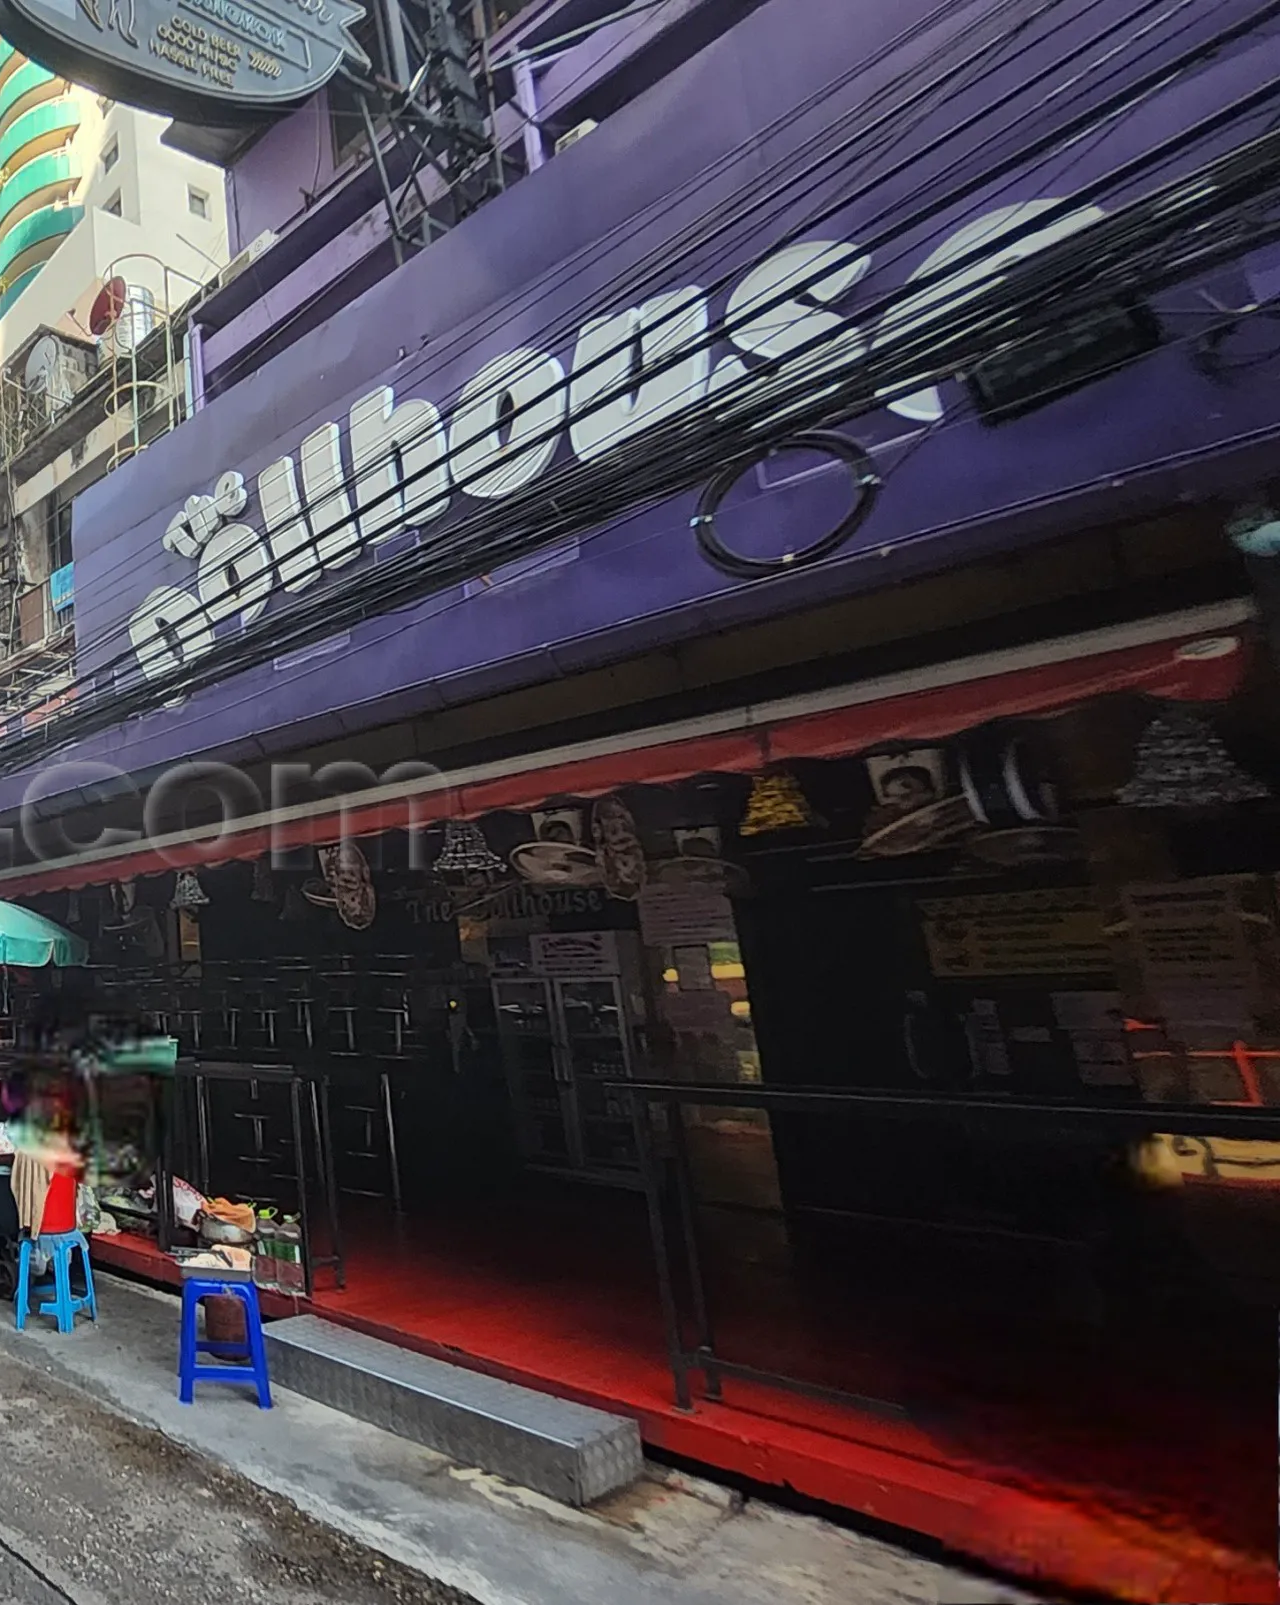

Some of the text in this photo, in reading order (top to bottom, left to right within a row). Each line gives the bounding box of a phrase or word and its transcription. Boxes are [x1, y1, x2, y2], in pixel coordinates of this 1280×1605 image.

[157, 24, 197, 53] GOOD
[197, 42, 239, 72] MUSIC
[171, 15, 242, 60] COLD BEER
